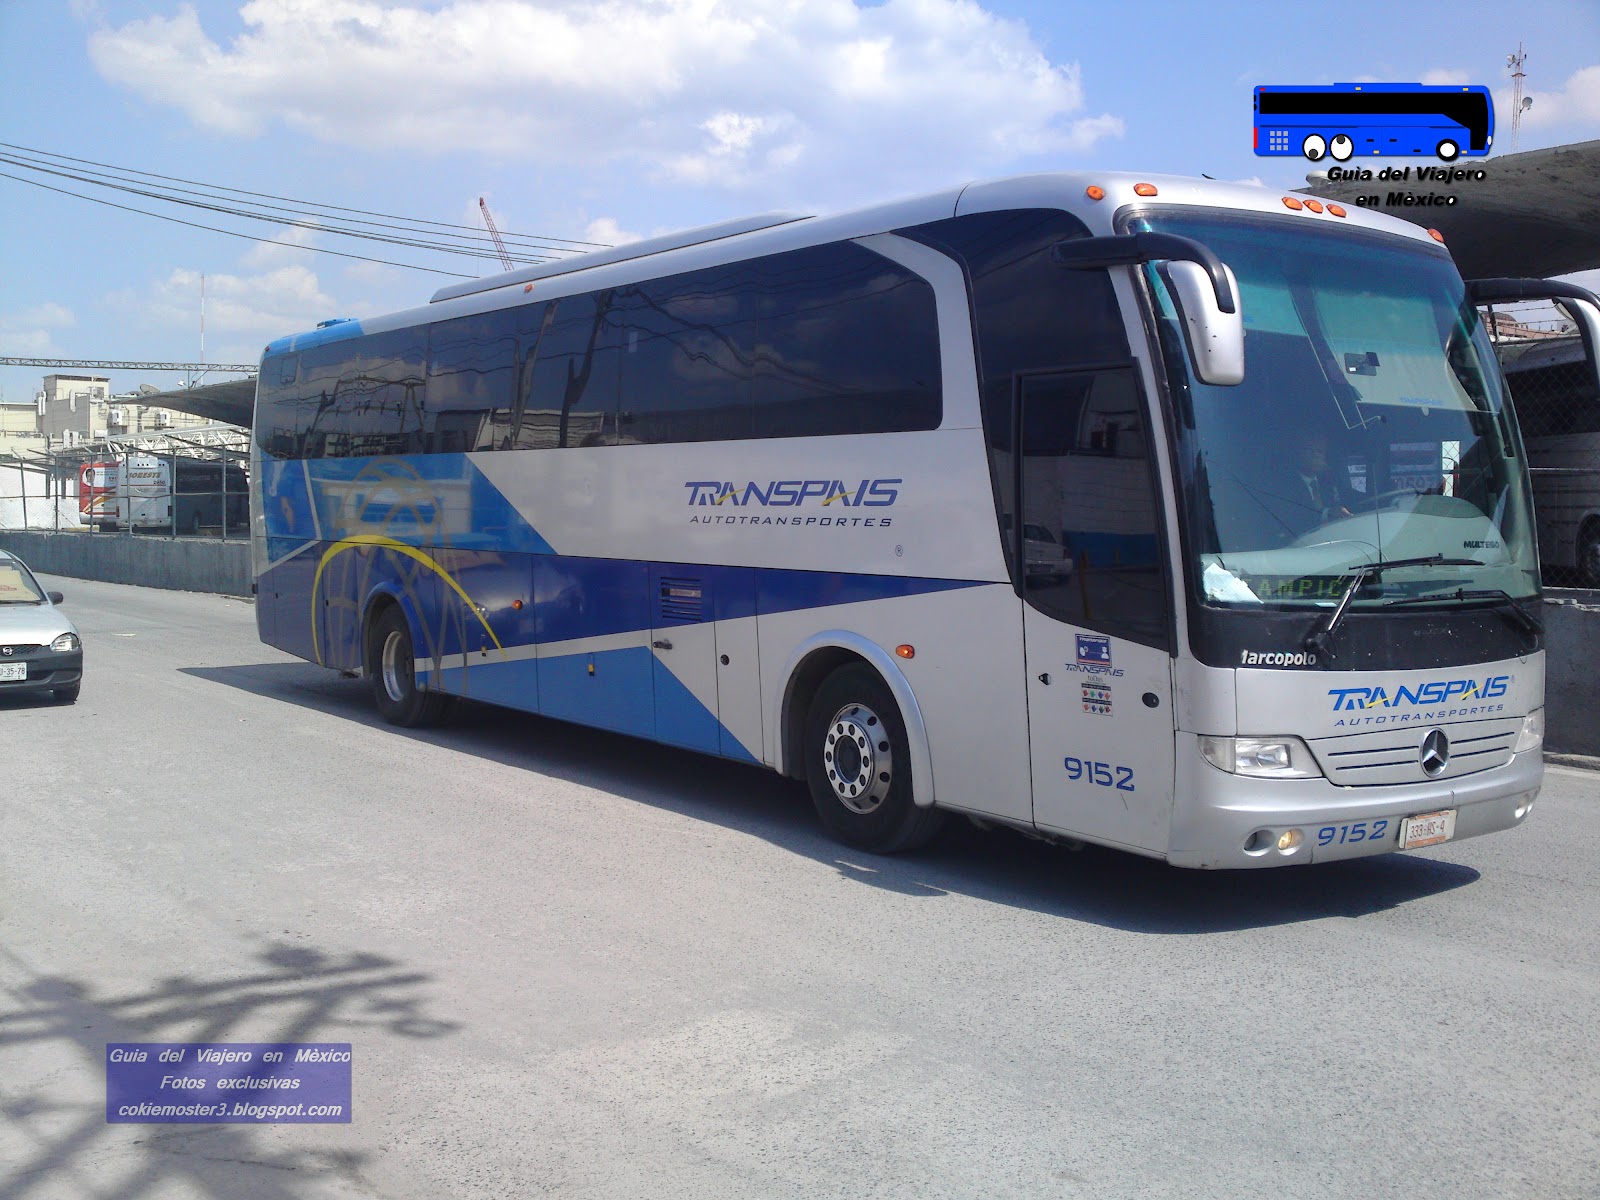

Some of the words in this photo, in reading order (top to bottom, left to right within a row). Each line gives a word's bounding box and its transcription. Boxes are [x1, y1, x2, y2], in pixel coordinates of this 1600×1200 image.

[684, 478, 902, 506] TRANSPAIS
[690, 515, 892, 527] AUTOTRANSPORTES
[1244, 579, 1352, 598] AMPIC
[1065, 663, 1124, 677] TRANSPAIS
[1327, 675, 1510, 711] TRANSPAIS
[1334, 703, 1505, 727] AUTOTRANSPORTES
[1064, 756, 1136, 792] 9152
[1317, 820, 1389, 847] 9152
